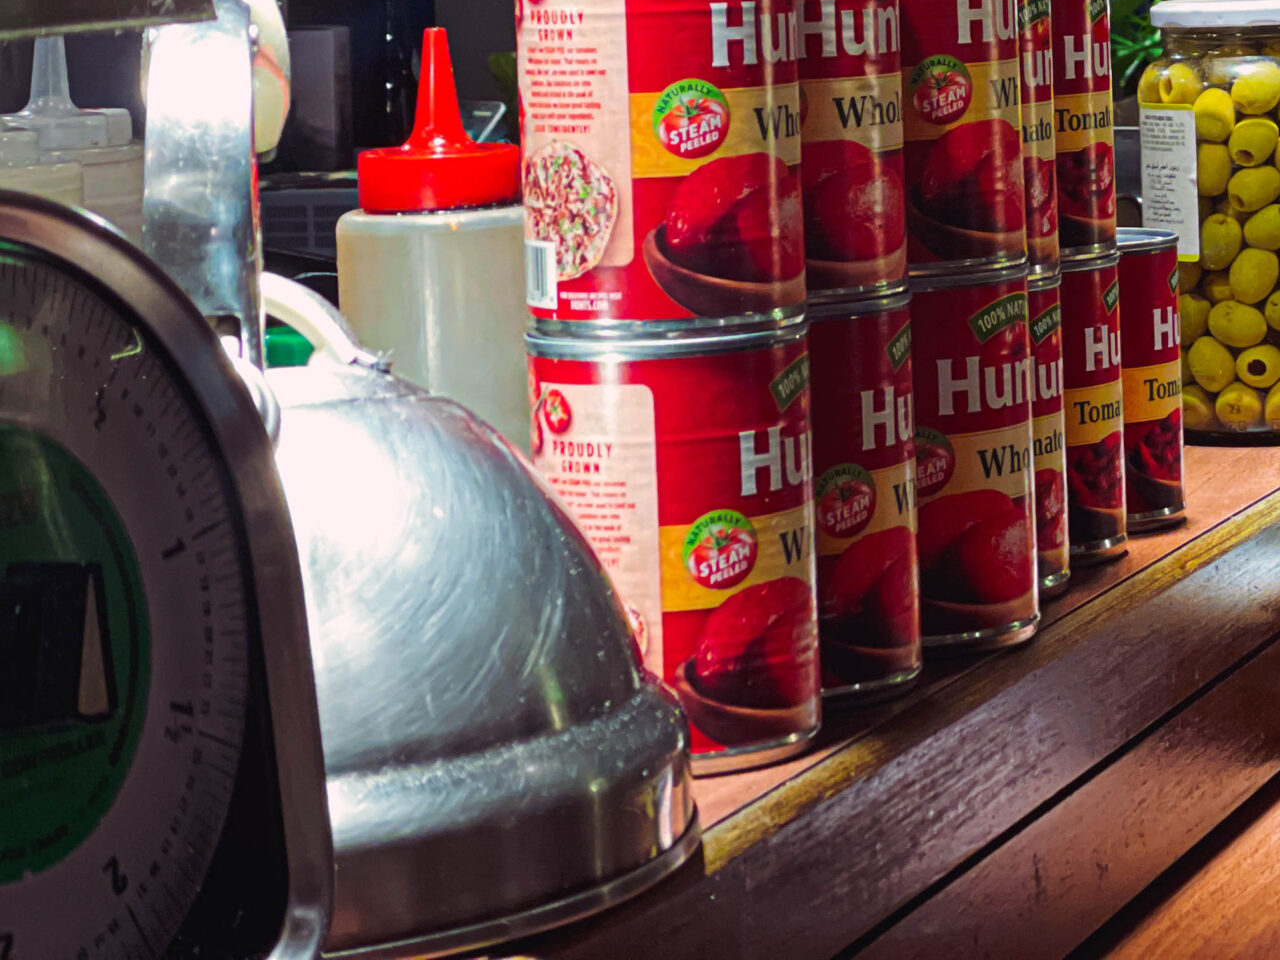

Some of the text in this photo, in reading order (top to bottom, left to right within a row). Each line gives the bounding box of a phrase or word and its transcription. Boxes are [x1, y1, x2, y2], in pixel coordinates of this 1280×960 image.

[530, 10, 584, 25] PROUDLY
[537, 29, 574, 42] GROWN
[911, 58, 957, 85] NATURALLY
[657, 84, 712, 113] NATURALLY
[832, 92, 902, 129] Whol
[923, 86, 966, 112] STEAM
[932, 100, 964, 119] PEELED
[669, 115, 721, 145] STEAM
[681, 131, 719, 153] PEELED
[978, 307, 1006, 332] 100%
[1144, 378, 1180, 401] Tom
[552, 441, 612, 458] PROUDLY
[561, 460, 600, 474] GROWN
[918, 458, 947, 478] EAM
[827, 495, 869, 526] STEAM
[836, 511, 868, 532] PEELED
[686, 515, 742, 546] NATURALLY
[699, 544, 750, 577] STEAM
[710, 561, 748, 585] PEELED
